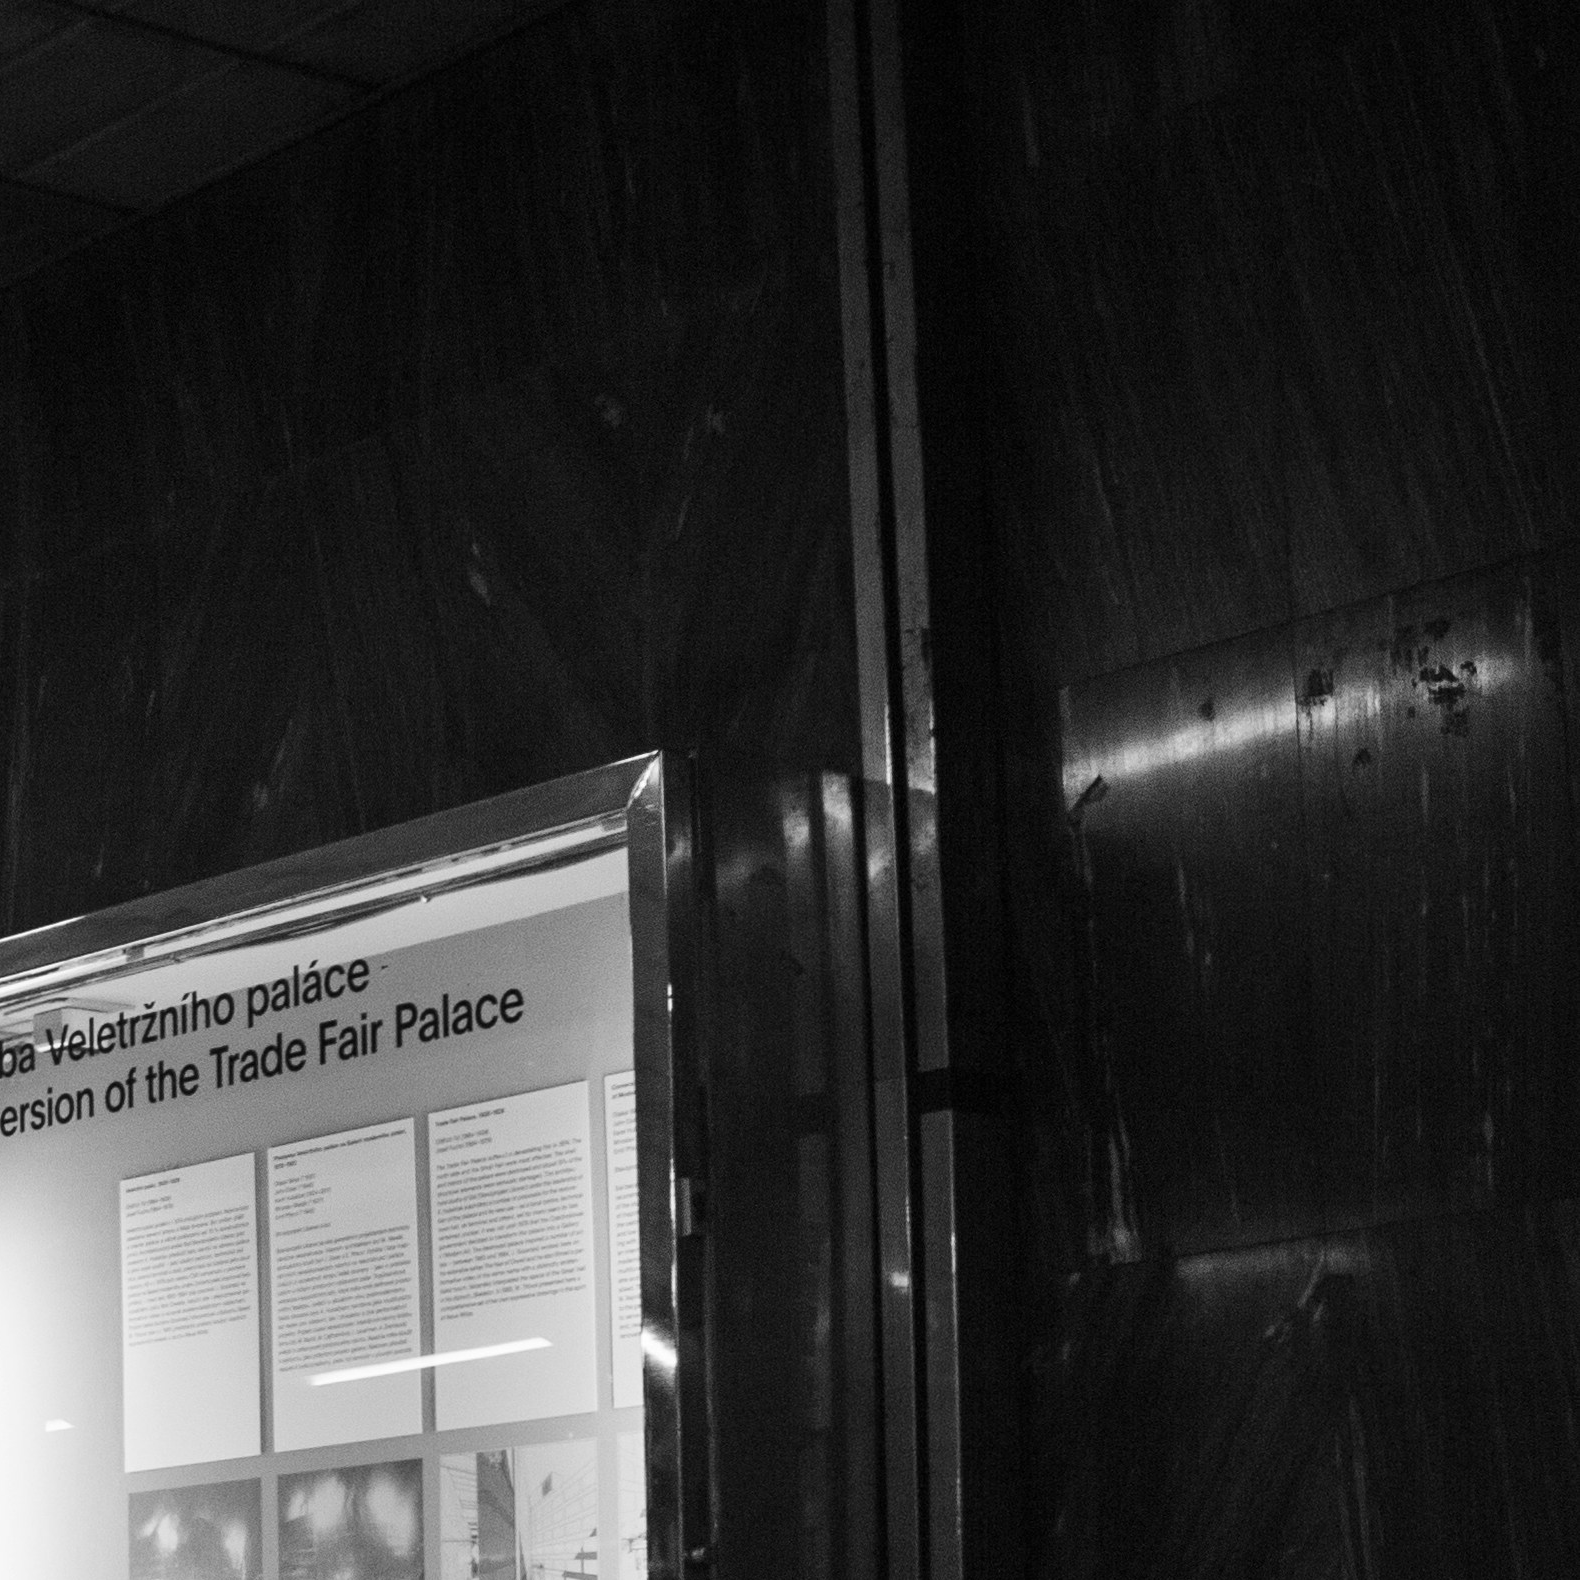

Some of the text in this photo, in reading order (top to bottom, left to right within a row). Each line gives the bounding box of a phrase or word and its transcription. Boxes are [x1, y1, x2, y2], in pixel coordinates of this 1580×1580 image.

[46, 991, 236, 1067] Veletržního
[246, 958, 370, 1028] paláce
[104, 1066, 137, 1113] of
[145, 1060, 200, 1104] the
[209, 1032, 308, 1089] Trade
[319, 1012, 384, 1065] Fair
[395, 988, 525, 1049] Palace
